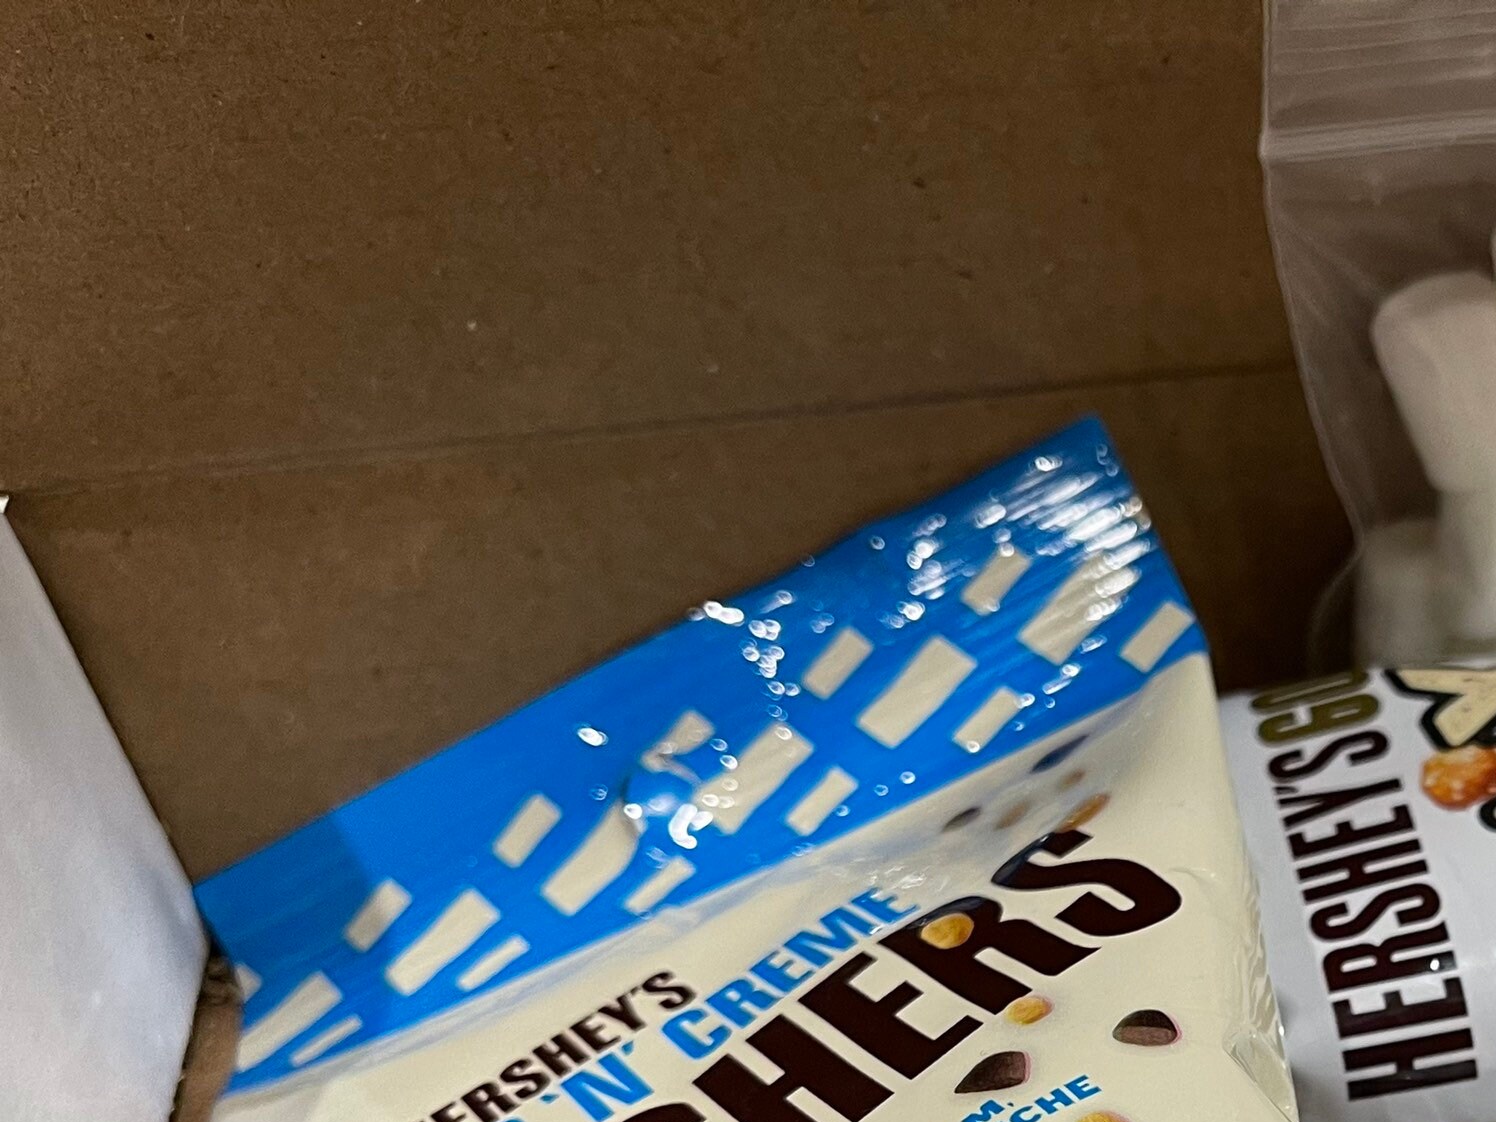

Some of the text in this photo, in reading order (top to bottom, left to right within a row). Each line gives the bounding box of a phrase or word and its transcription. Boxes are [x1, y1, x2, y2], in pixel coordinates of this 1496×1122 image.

[660, 886, 923, 1060] CREME
[1251, 670, 1479, 1101] HERSHEY'S GO
